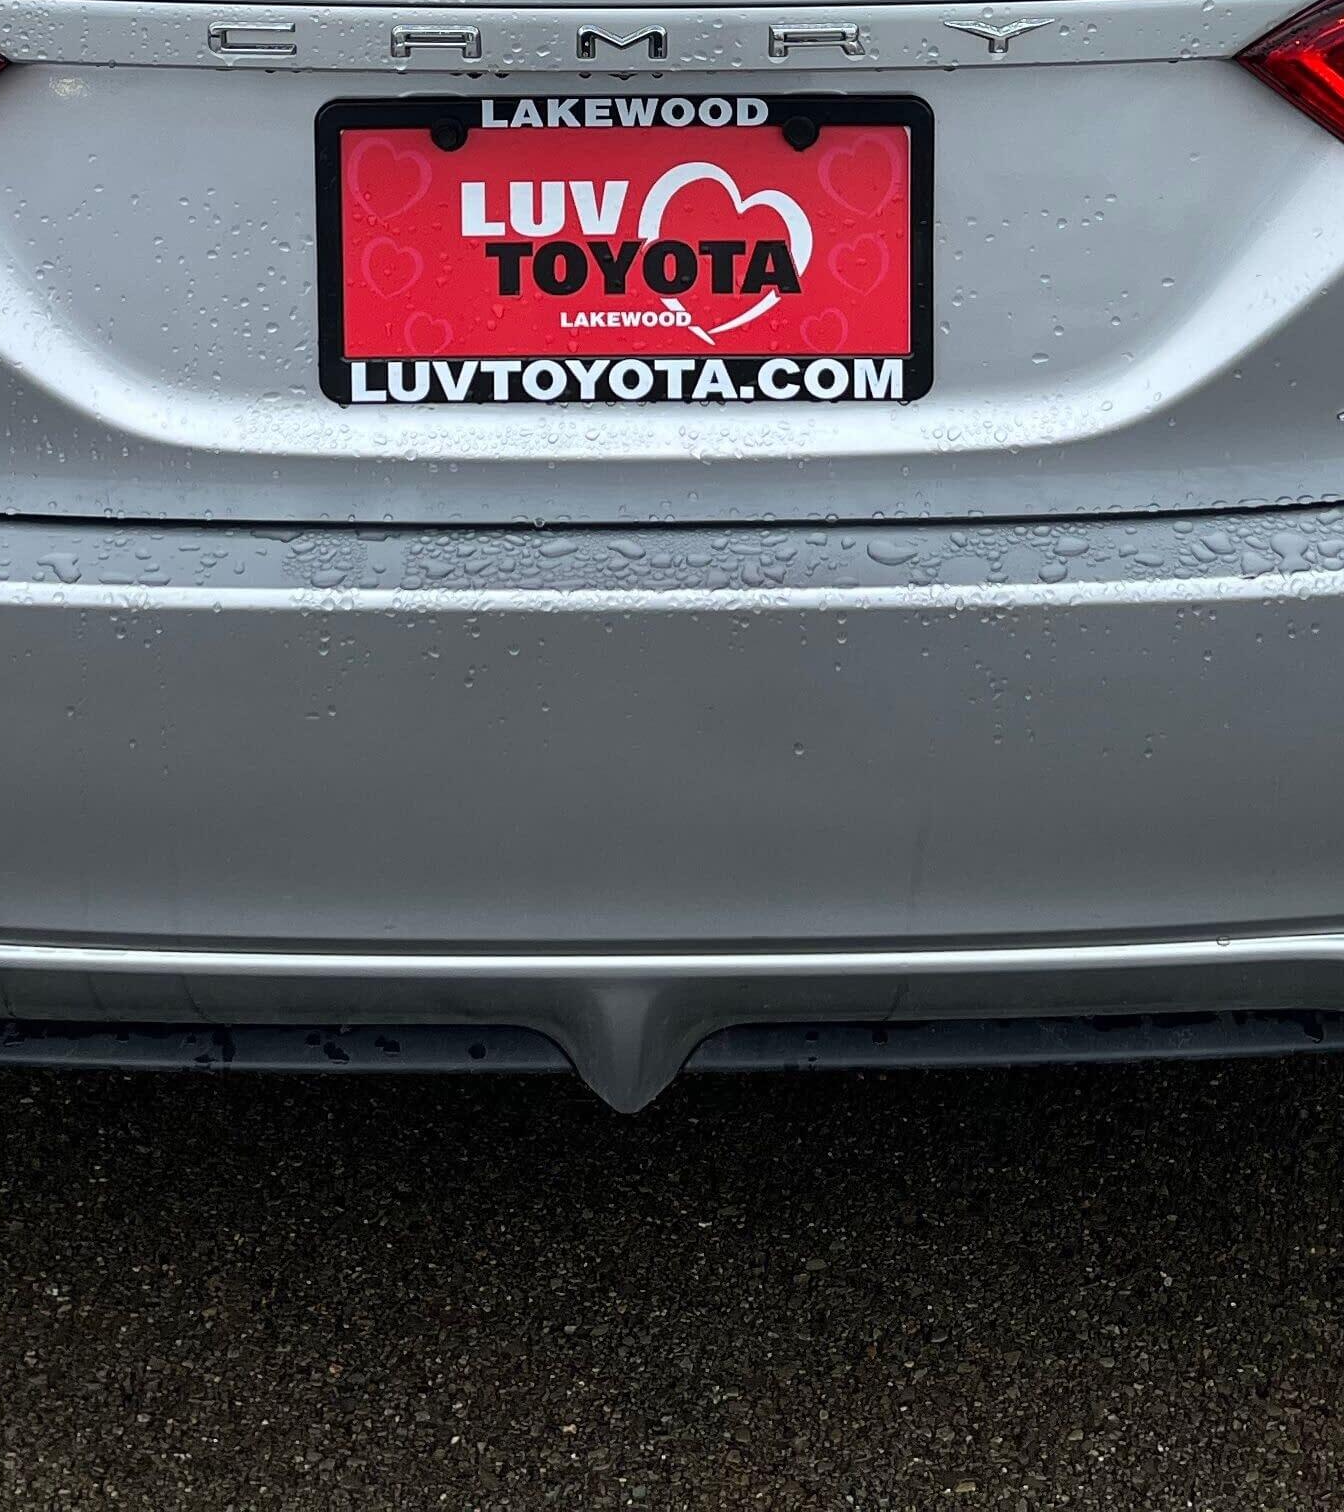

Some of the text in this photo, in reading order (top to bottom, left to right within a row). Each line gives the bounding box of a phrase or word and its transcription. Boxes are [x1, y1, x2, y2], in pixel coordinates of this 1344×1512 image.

[207, 17, 1055, 60] CAMRY
[480, 98, 769, 128] LAKEWOOD
[460, 179, 630, 237] LUV
[485, 240, 802, 296] TOYOTA
[559, 309, 692, 328] LAKEWOOD
[350, 358, 904, 402] LUVTOYOTA.COM
